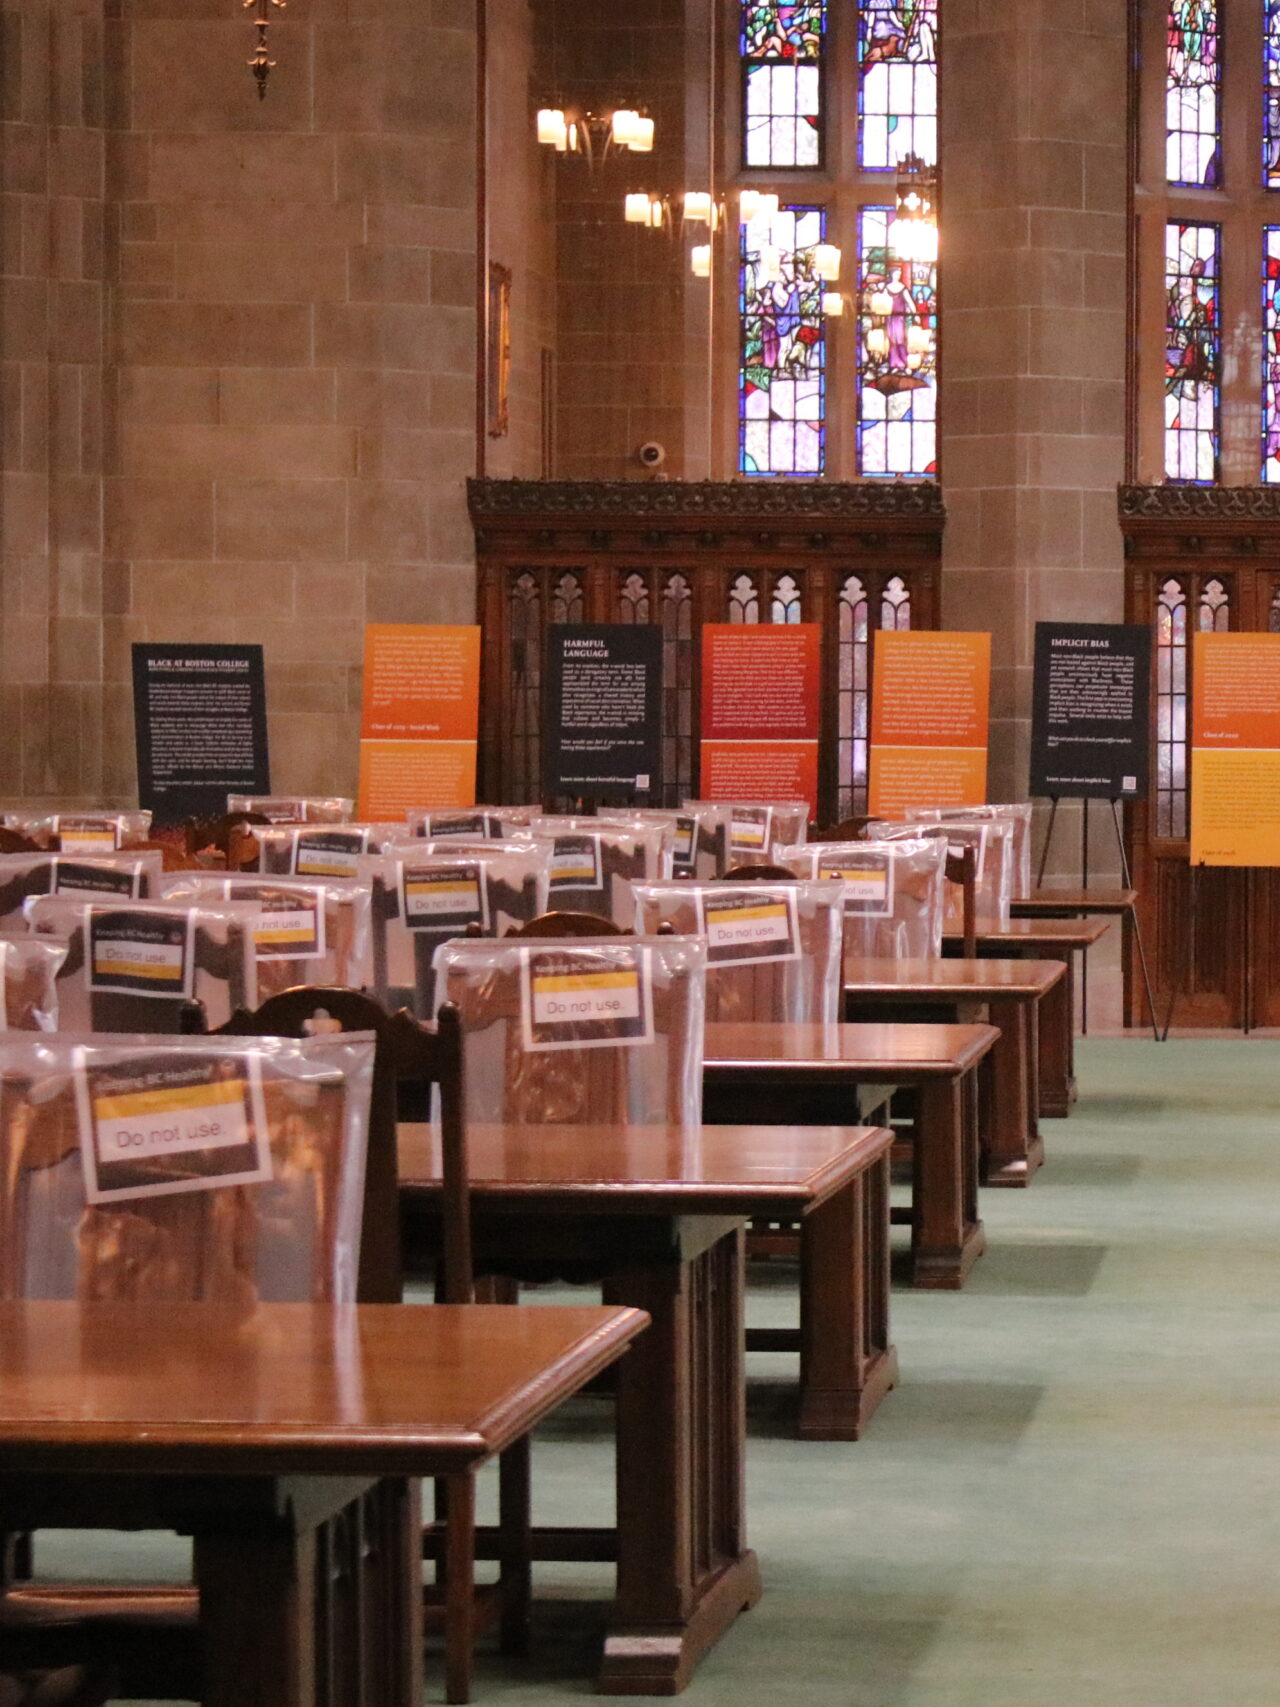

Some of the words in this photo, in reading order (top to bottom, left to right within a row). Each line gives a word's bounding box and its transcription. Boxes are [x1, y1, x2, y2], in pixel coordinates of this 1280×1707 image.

[564, 639, 606, 648] HARMFUL
[1051, 639, 1088, 648] IMPLICIT
[1090, 640, 1110, 648] BIAS
[564, 649, 610, 658] LANGUAGE
[148, 659, 172, 668] BLACK
[174, 659, 184, 668] AT
[185, 660, 216, 668] BOSTON
[217, 660, 250, 668] COLLEGE
[106, 948, 123, 961] Do
[125, 950, 143, 961] not
[145, 953, 167, 964] use
[536, 964, 569, 974] Keeping
[571, 961, 582, 972] BC
[584, 959, 616, 971] Healthy
[547, 1001, 567, 1014] Do
[571, 1000, 592, 1013] not
[117, 1130, 144, 1149] Do
[150, 1126, 181, 1144] not
